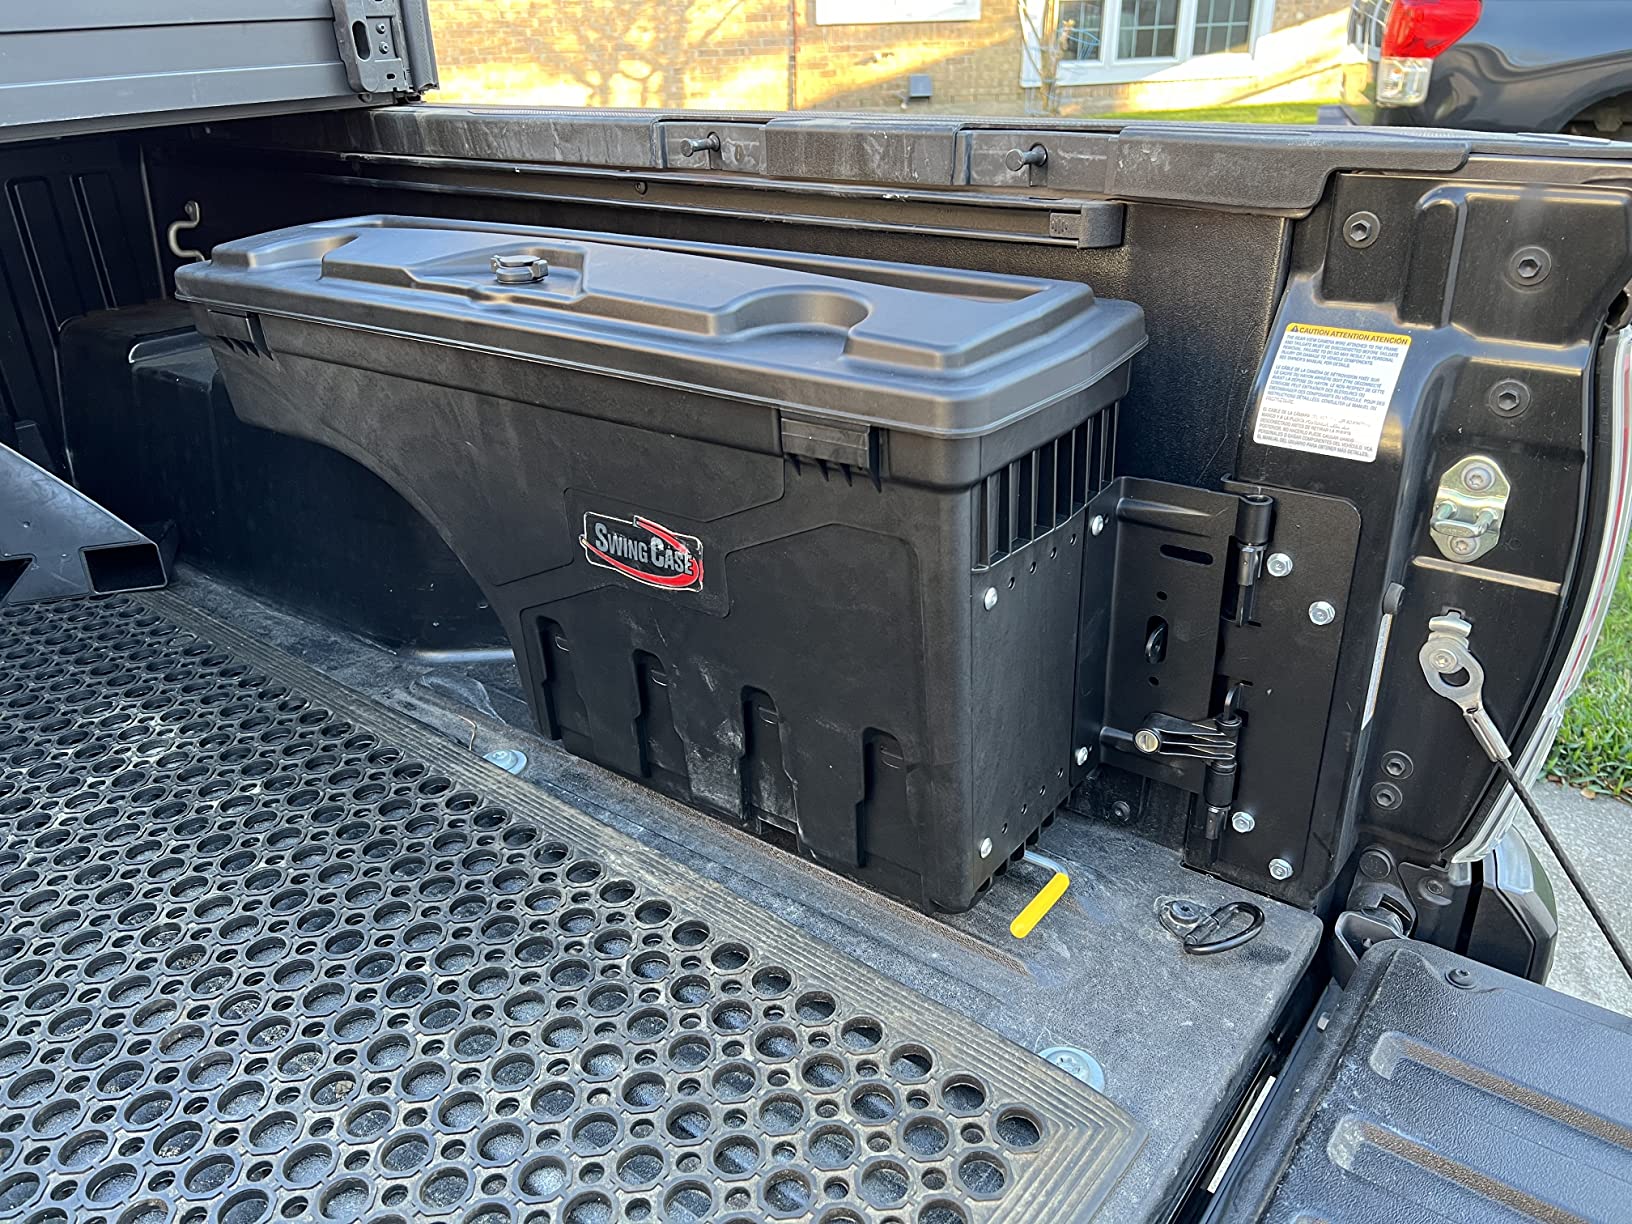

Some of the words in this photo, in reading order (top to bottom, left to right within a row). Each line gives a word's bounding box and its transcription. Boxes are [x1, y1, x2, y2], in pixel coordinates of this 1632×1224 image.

[1299, 327, 1329, 336] CAUTION
[1330, 331, 1370, 340] ATTENTION
[1371, 334, 1408, 345] ATENCIÓN
